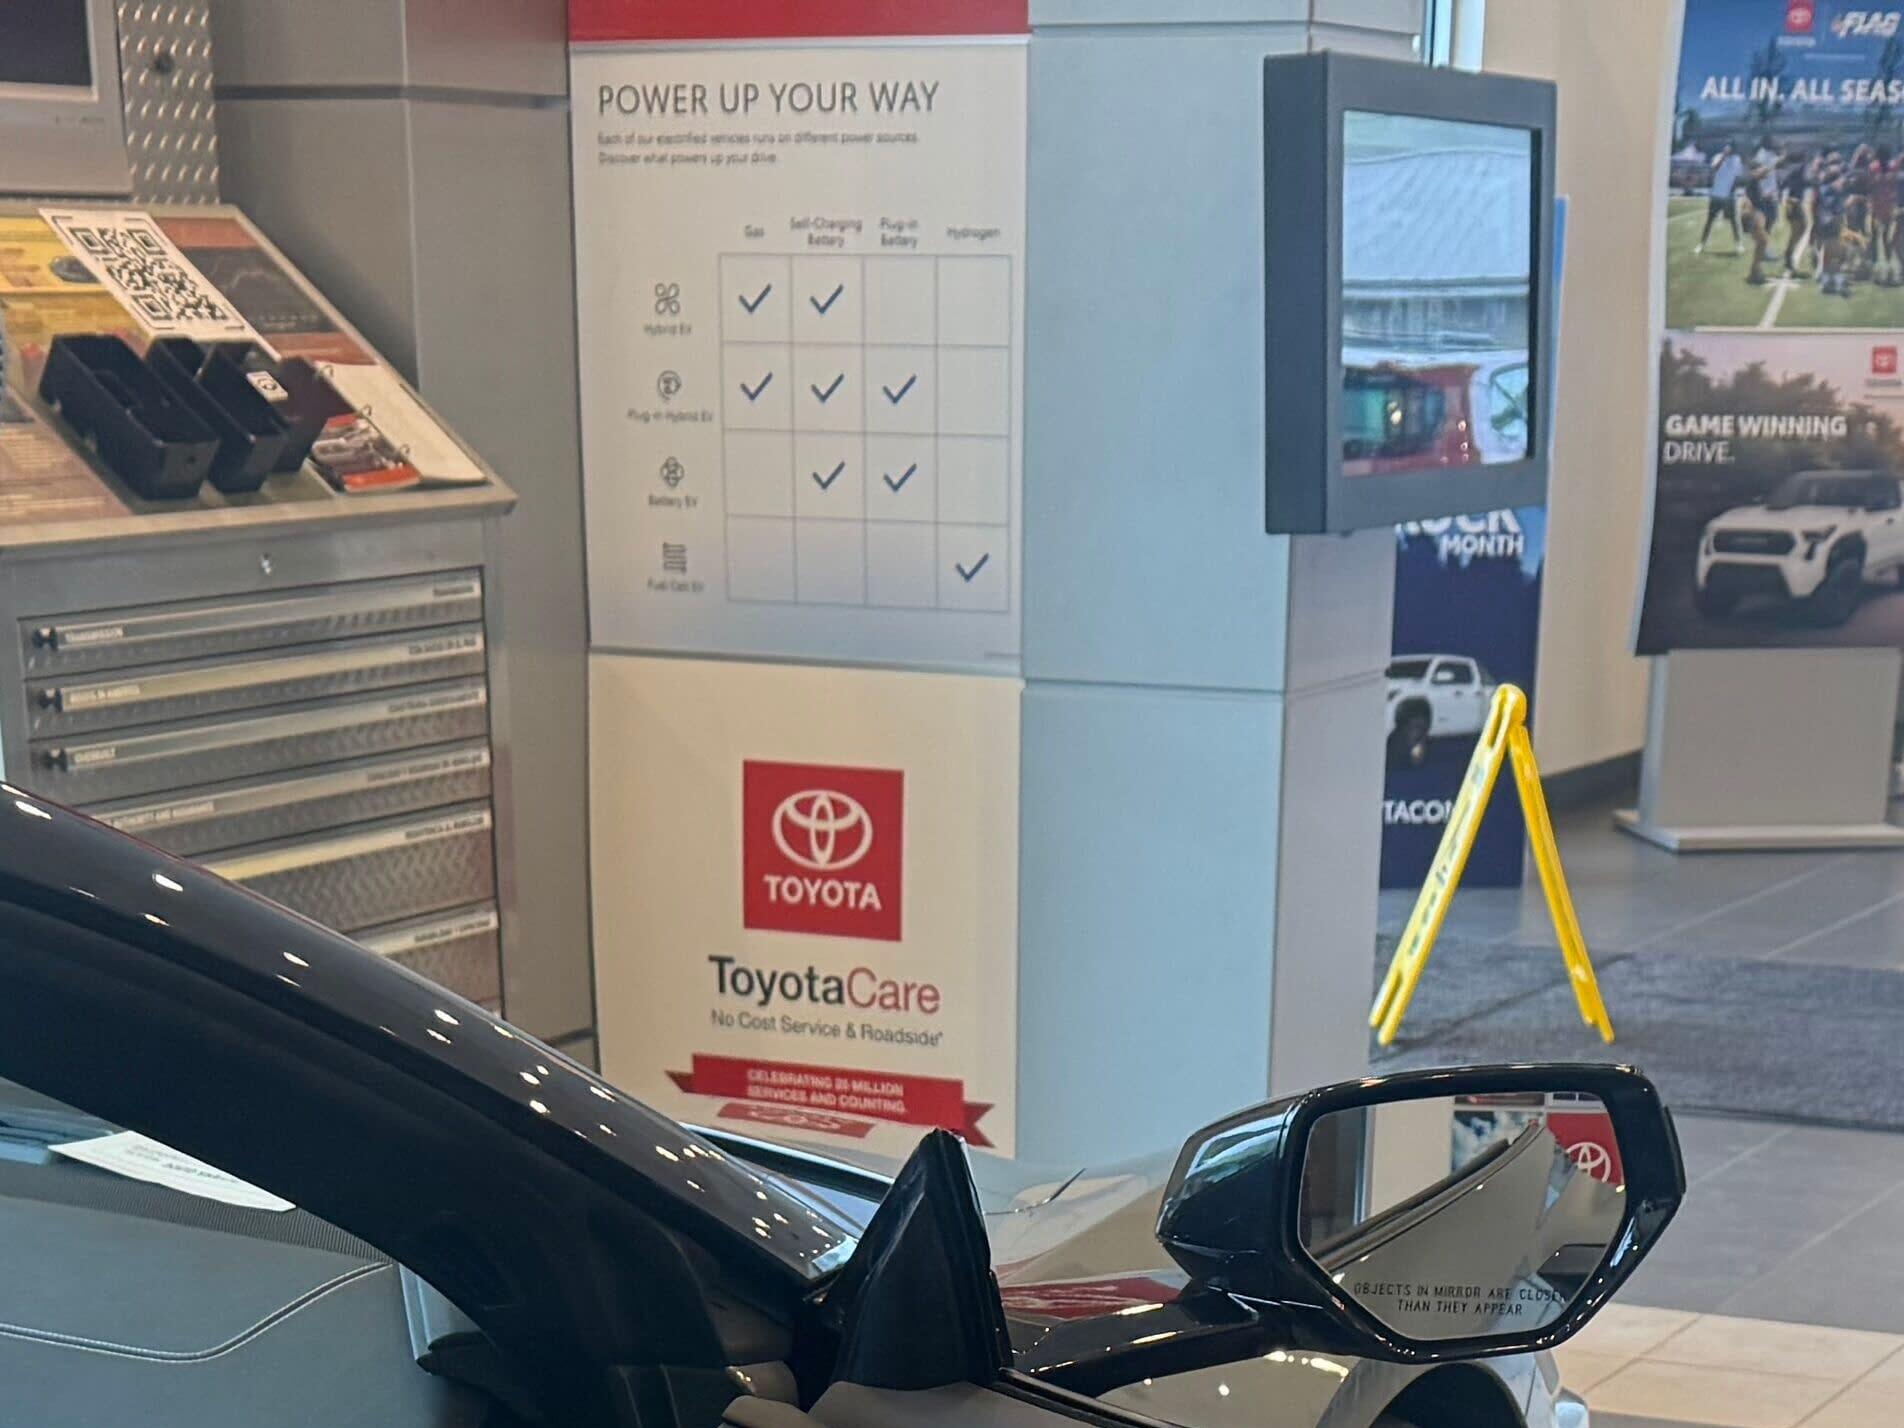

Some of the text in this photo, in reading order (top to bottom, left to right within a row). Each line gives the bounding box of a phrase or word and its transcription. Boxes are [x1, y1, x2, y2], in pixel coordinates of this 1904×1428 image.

[598, 81, 939, 115] POWER UP YOUR WAY
[1701, 76, 1744, 100] ALL
[1749, 76, 1785, 103] IN.
[1790, 77, 1833, 101] ALL
[1665, 414, 1848, 440] GAME WINNING
[1663, 440, 1735, 464] DRIVE.
[1440, 533, 1524, 557] MONTH
[763, 874, 882, 911] TOYOTA
[708, 954, 941, 1015] ToyotaCare
[711, 1009, 735, 1026] No
[737, 1012, 777, 1031] Cost
[781, 1015, 841, 1038] Service
[846, 1023, 857, 1039] &
[747, 1068, 833, 1090] CELEBRATING
[851, 1080, 905, 1098] MILLION
[809, 1091, 837, 1106] AND
[1354, 1283, 1411, 1297] OBJECTS
[1417, 1285, 1429, 1296] IN
[1434, 1286, 1481, 1298] MIRROR
[1488, 1287, 1511, 1299] ARE
[1398, 1299, 1524, 1316] THAN THEY APPEAR
